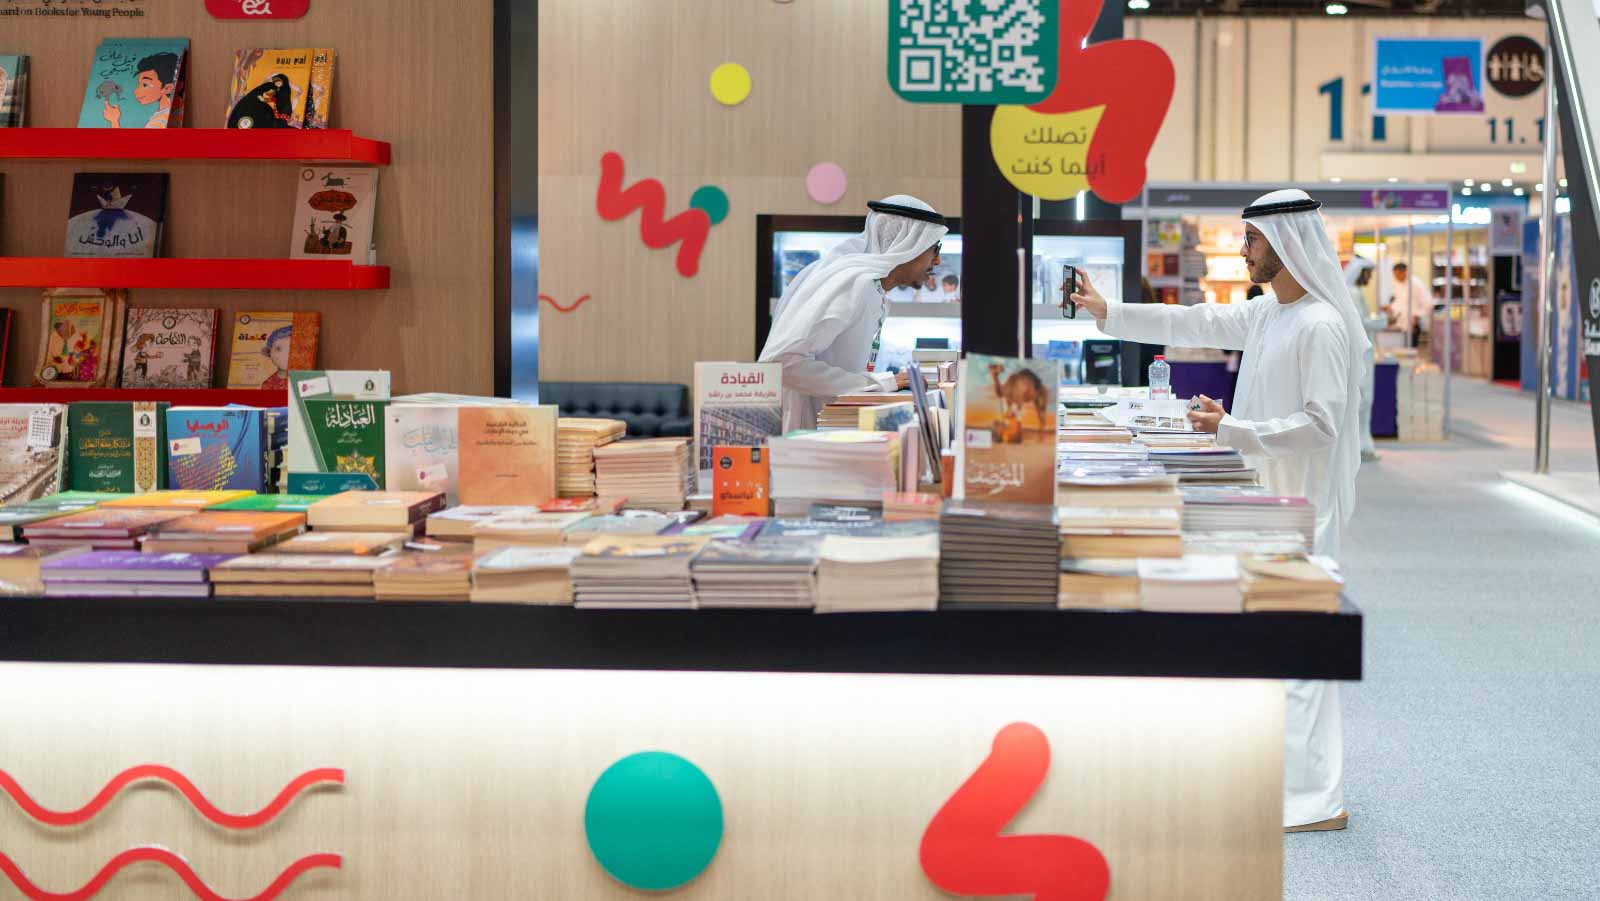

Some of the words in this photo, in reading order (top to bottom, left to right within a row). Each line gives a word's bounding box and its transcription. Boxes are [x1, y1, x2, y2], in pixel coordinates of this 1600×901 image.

[20, 8, 33, 16] on
[35, 8, 64, 16] Books
[65, 8, 79, 16] for
[81, 8, 111, 18] Young
[112, 8, 145, 18] People
[1023, 126, 1087, 145] تصلك
[1010, 156, 1053, 175] كنت
[1060, 153, 1105, 180] أينما
[128, 221, 144, 244] أنا
[720, 372, 765, 389] القيادة
[708, 389, 724, 399] راشد
[724, 391, 733, 399] بن
